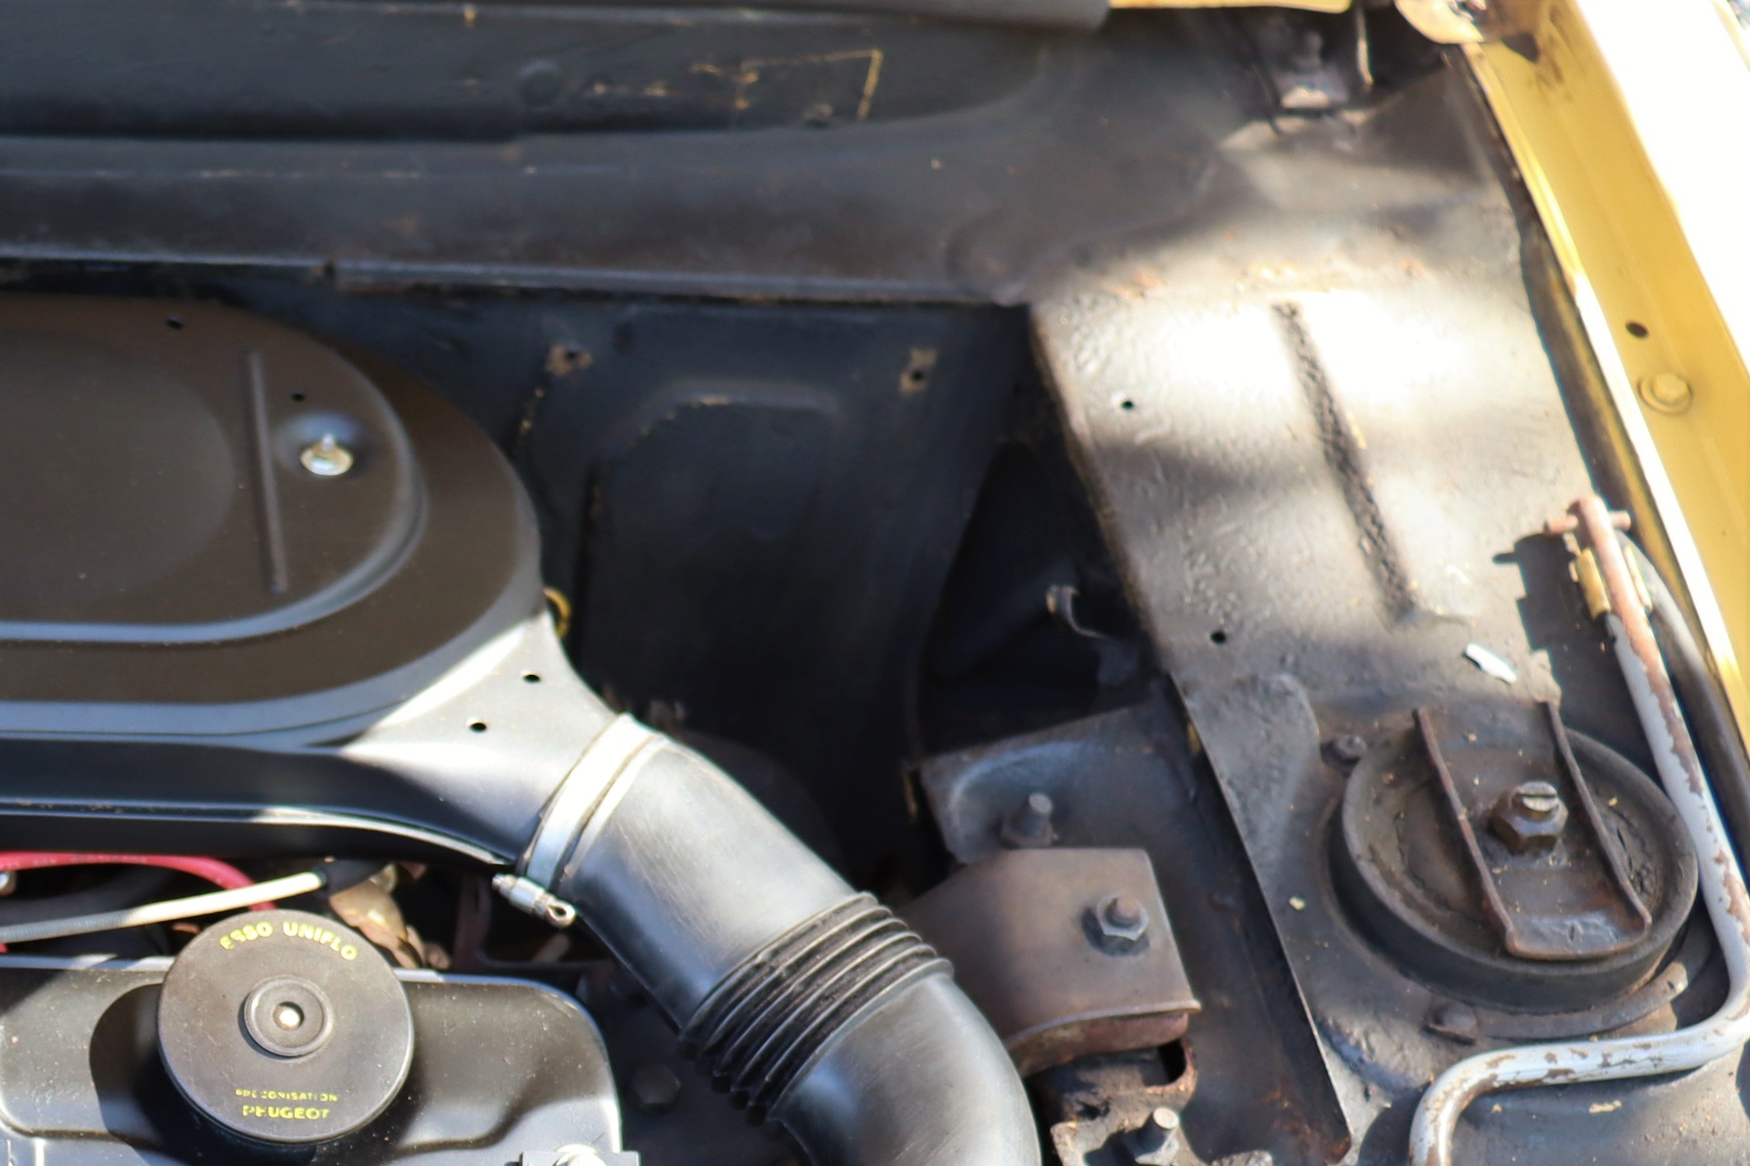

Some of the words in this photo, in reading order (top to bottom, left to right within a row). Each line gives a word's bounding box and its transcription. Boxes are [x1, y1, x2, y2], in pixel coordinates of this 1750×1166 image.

[219, 921, 274, 951] ESSO
[282, 921, 358, 961] UNIFLO
[242, 1105, 330, 1119] PEUGEOT
